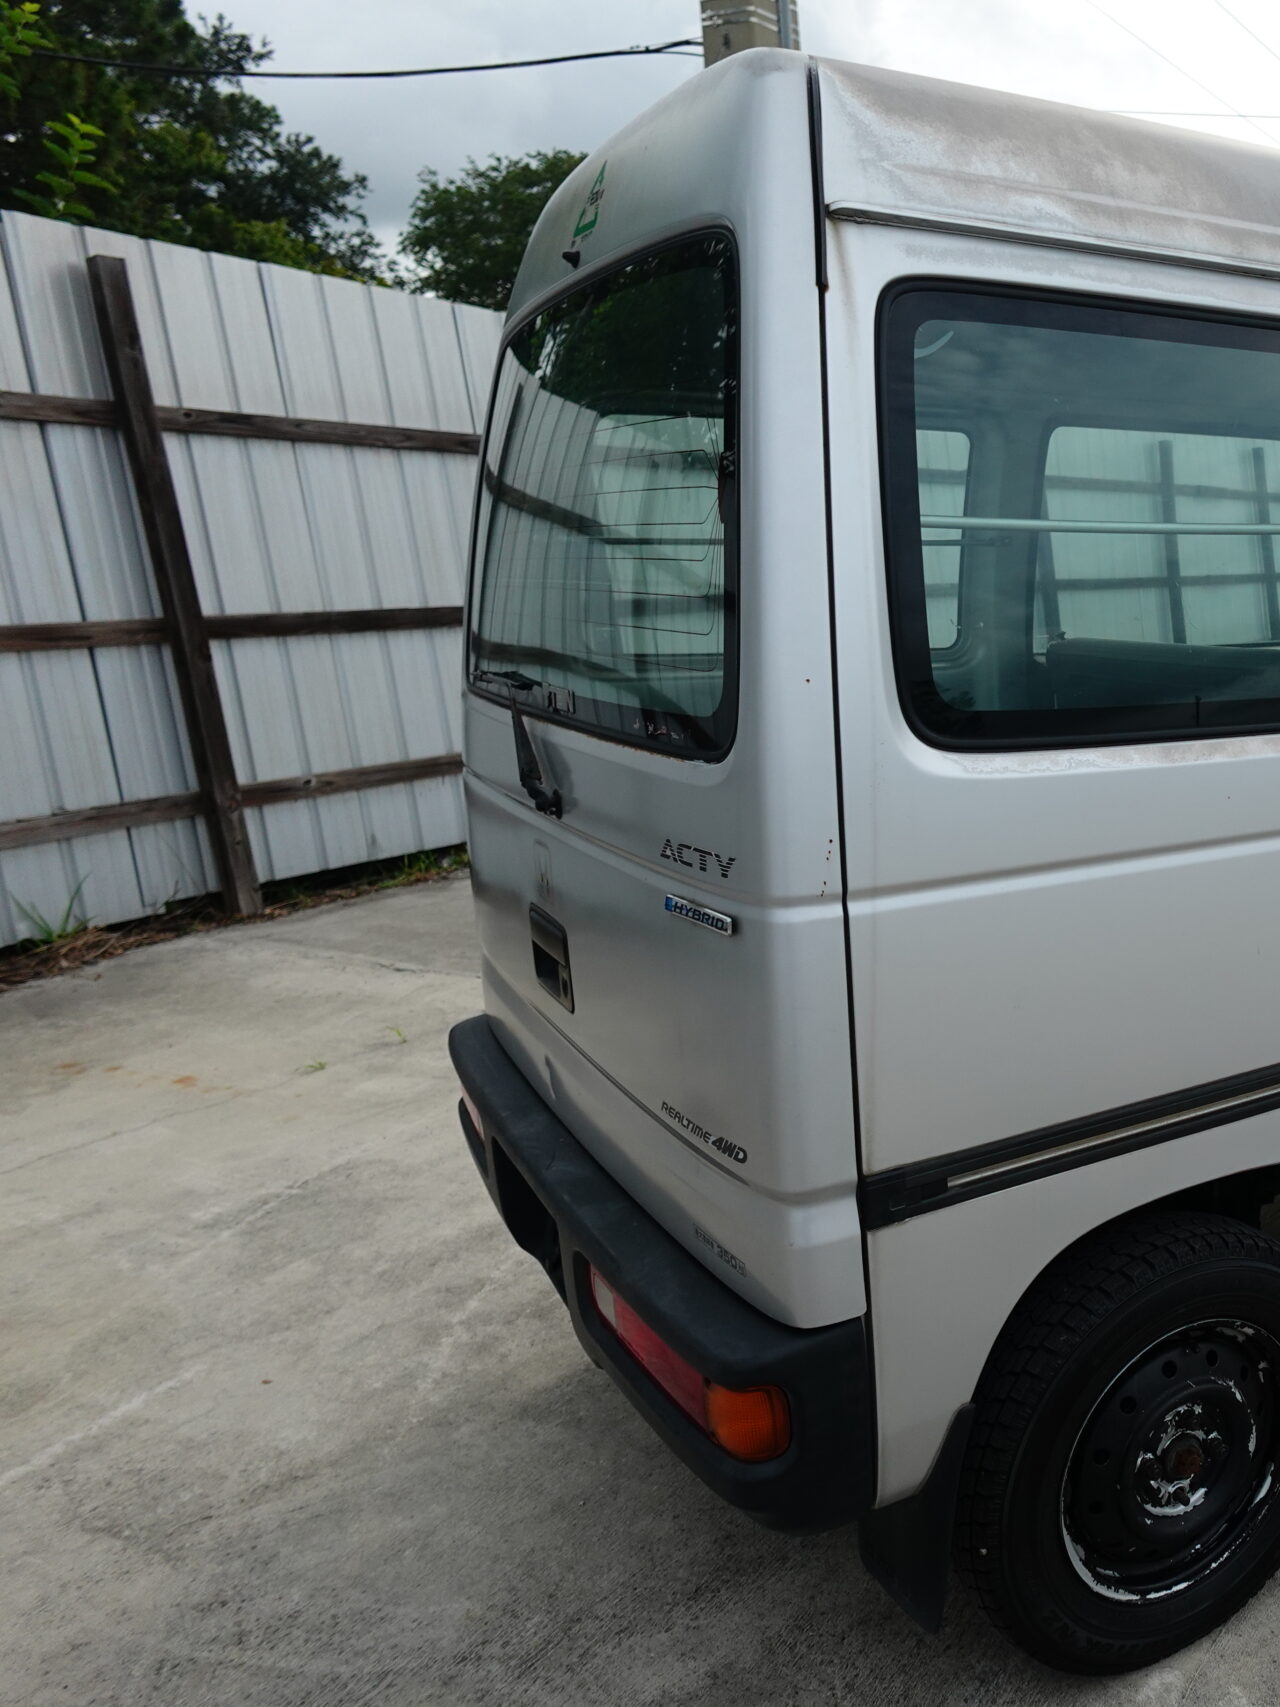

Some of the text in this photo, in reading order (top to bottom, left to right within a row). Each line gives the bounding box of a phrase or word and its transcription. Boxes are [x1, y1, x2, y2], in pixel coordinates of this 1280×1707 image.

[660, 838, 736, 878] ACTY
[673, 901, 725, 931] HYBRID
[661, 1101, 748, 1164] REALTIME 4WD
